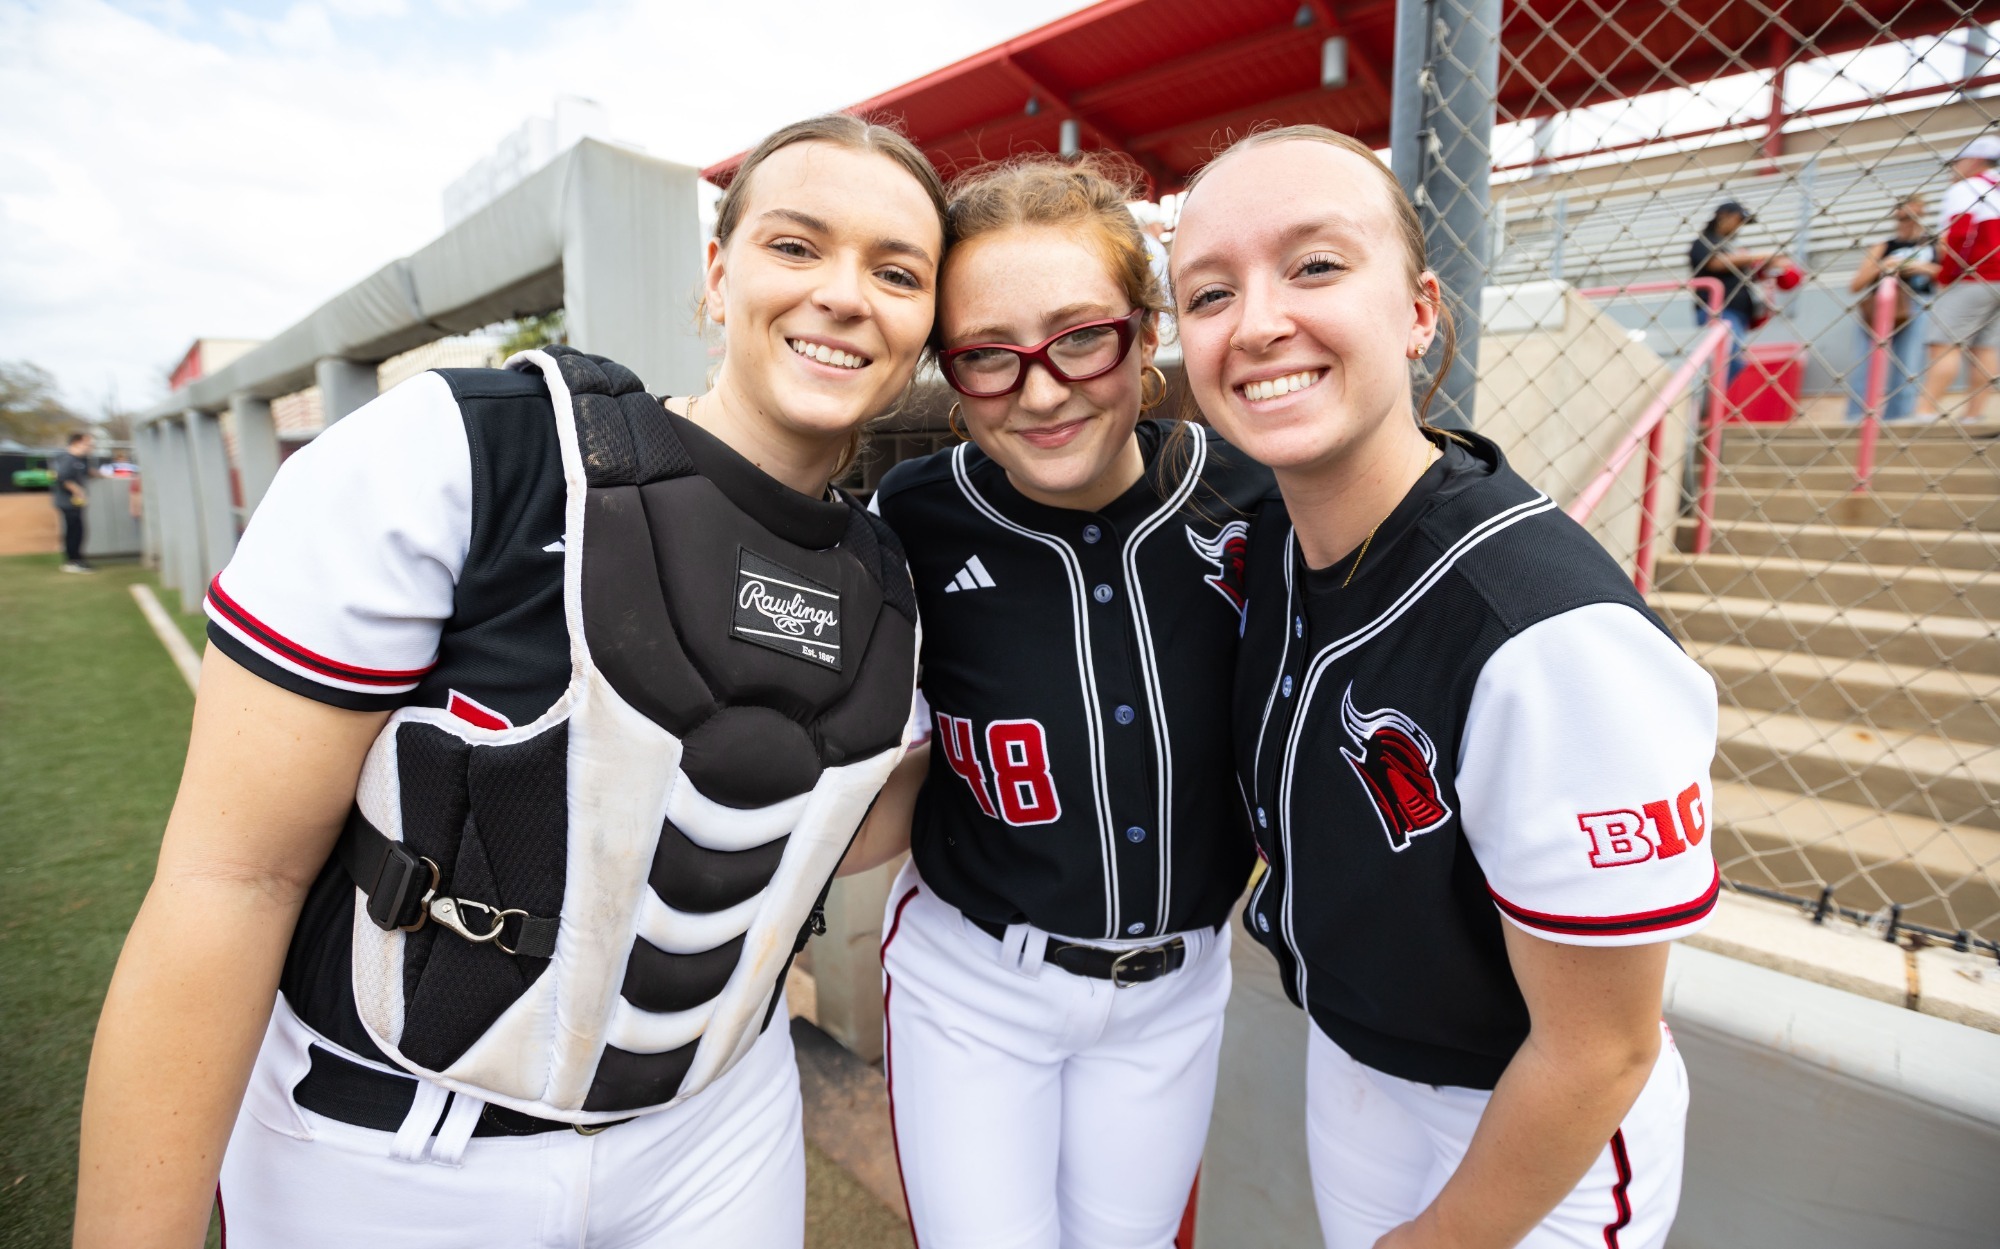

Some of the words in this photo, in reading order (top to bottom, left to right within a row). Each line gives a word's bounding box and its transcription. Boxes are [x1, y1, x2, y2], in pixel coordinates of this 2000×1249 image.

[739, 580, 838, 636] Rawlings
[802, 645, 817, 658] Est.
[936, 711, 1062, 827] 48
